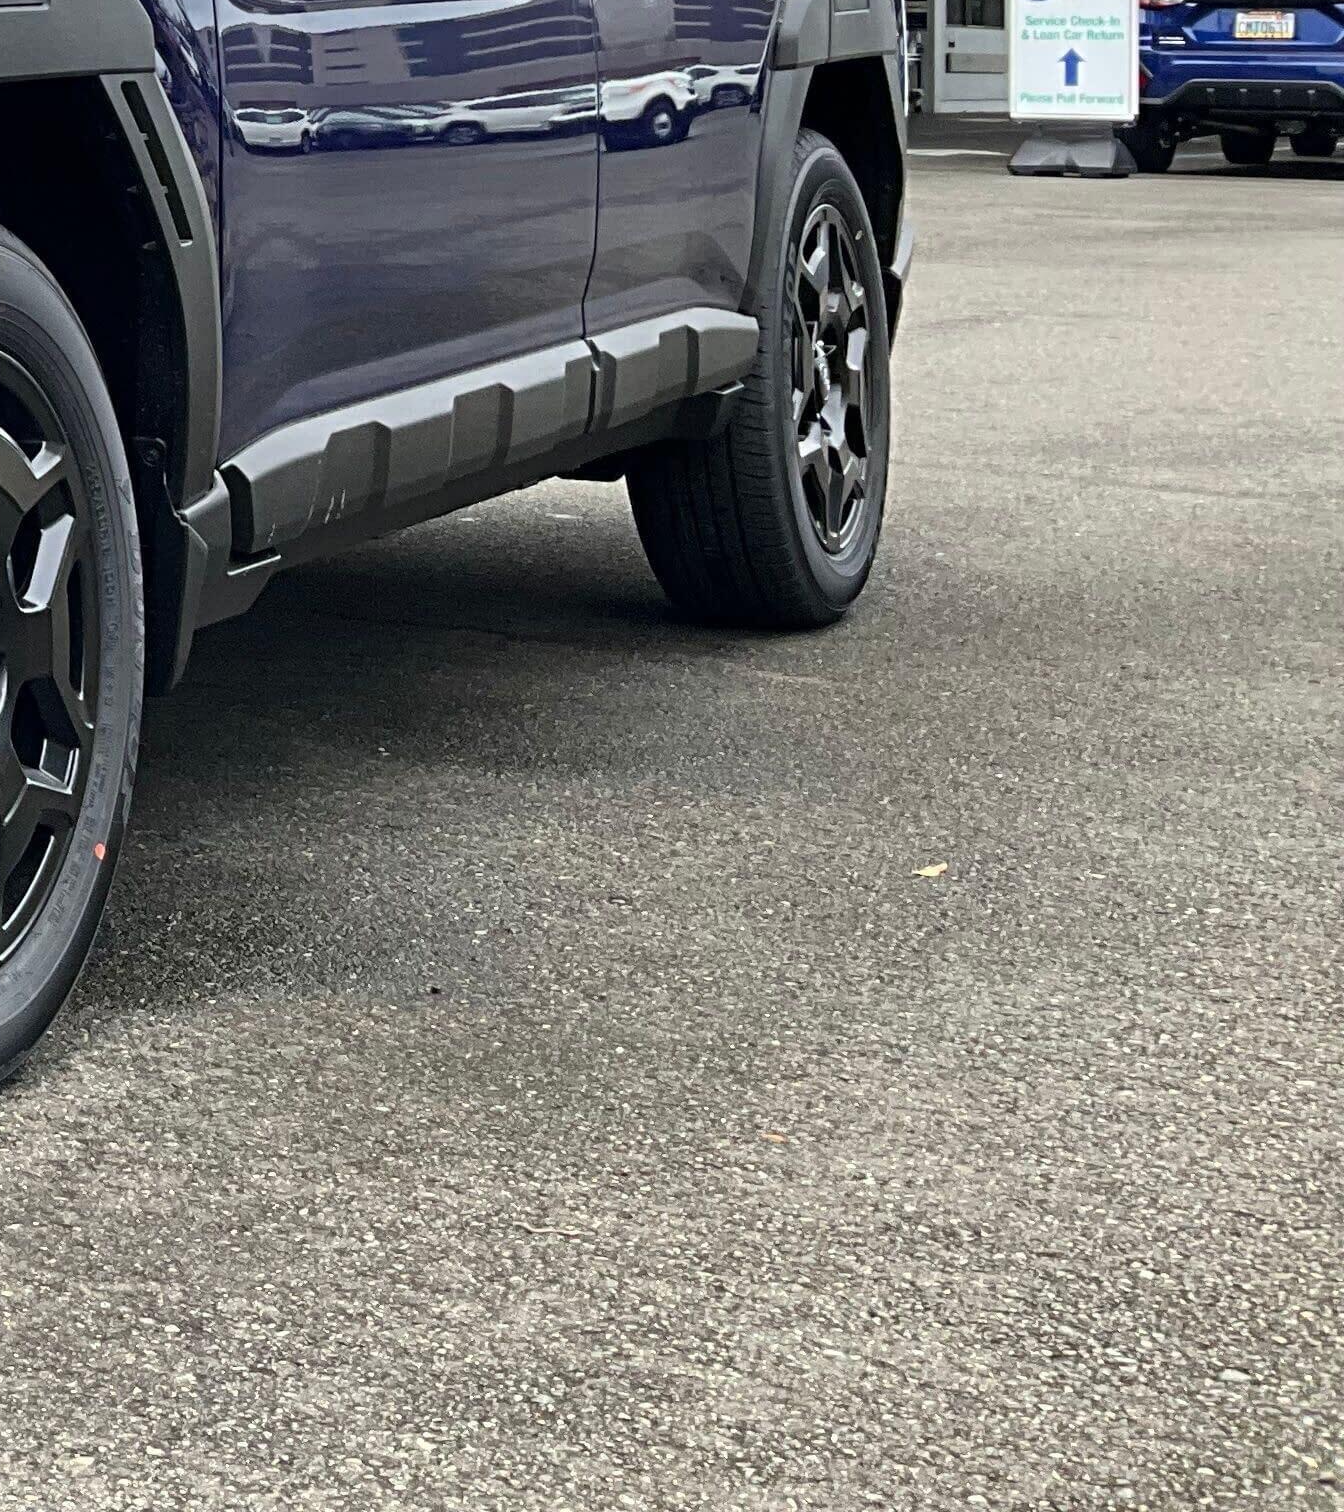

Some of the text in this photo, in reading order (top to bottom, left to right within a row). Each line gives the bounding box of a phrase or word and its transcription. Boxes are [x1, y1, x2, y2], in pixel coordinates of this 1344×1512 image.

[1025, 15, 1120, 26] Service Check-In
[1033, 29, 1060, 40] Loan
[1063, 29, 1082, 40] Car
[1087, 29, 1125, 40] Return
[1020, 92, 1124, 105] Please Pull Forward
